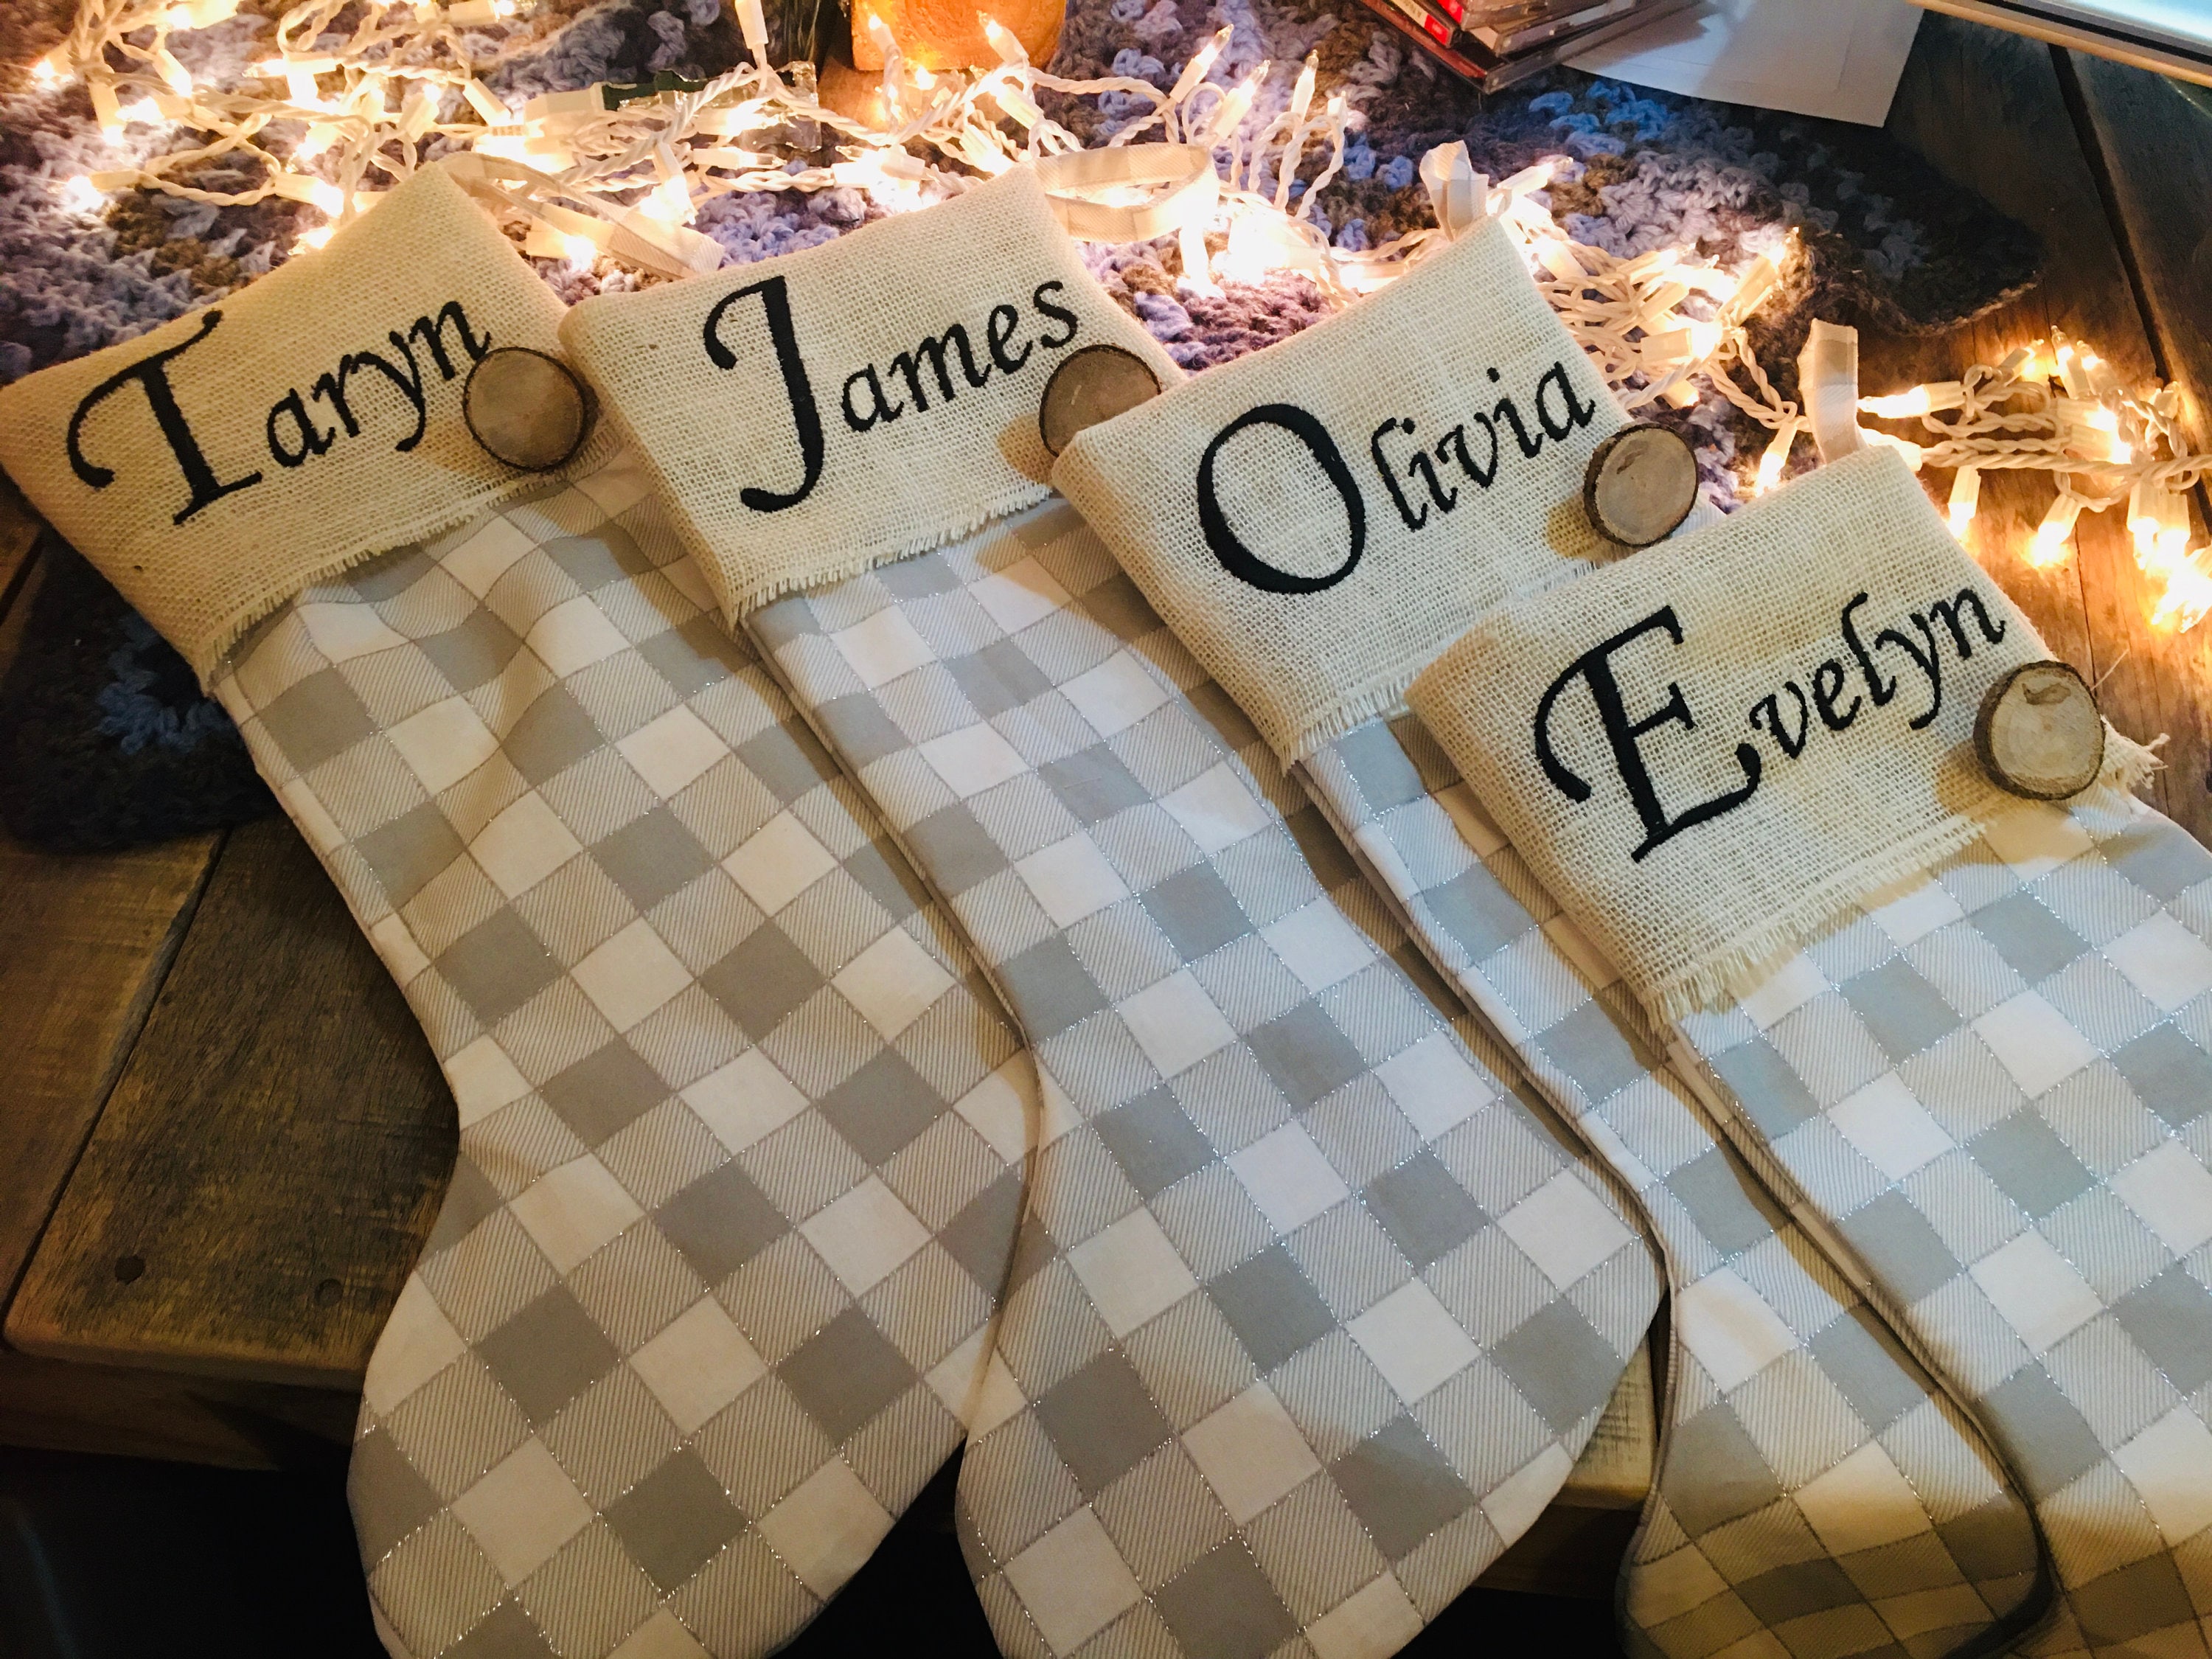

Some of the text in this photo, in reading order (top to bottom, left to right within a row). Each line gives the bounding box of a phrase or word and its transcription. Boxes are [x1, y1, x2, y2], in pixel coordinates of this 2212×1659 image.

[64, 299, 493, 526] Taryn
[703, 275, 1079, 513] James
[1196, 361, 1596, 595] Olivia
[1532, 588, 2006, 863] Evelyn
